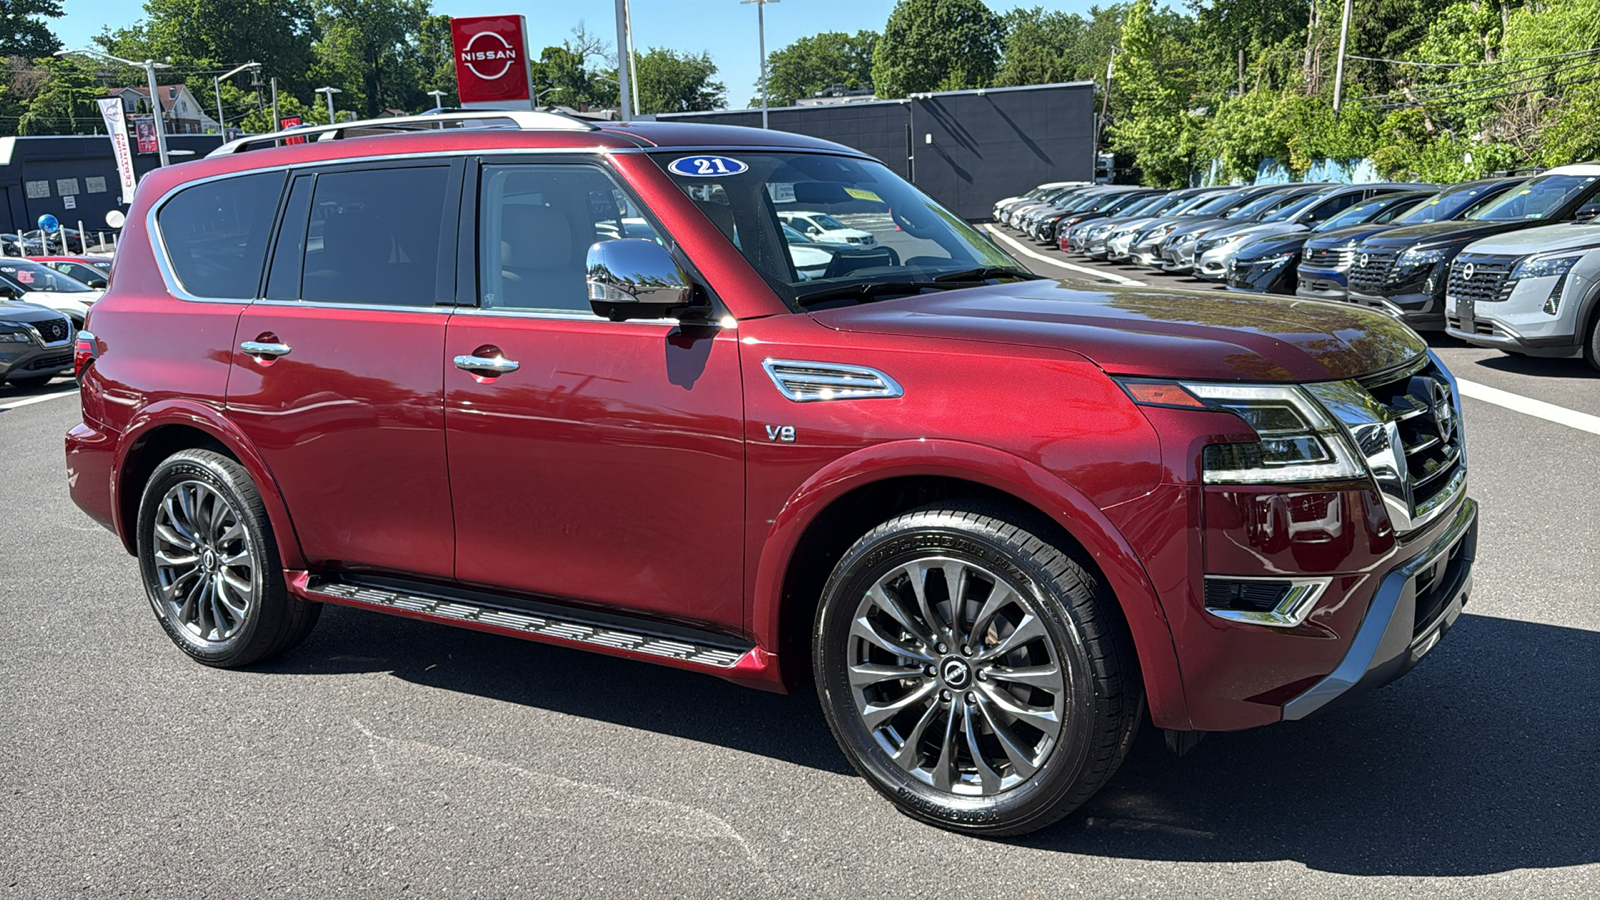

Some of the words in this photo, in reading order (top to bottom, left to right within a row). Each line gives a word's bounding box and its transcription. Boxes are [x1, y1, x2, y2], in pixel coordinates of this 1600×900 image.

[461, 49, 516, 62] NISSAN
[693, 158, 730, 174] 21
[765, 424, 796, 442] V8
